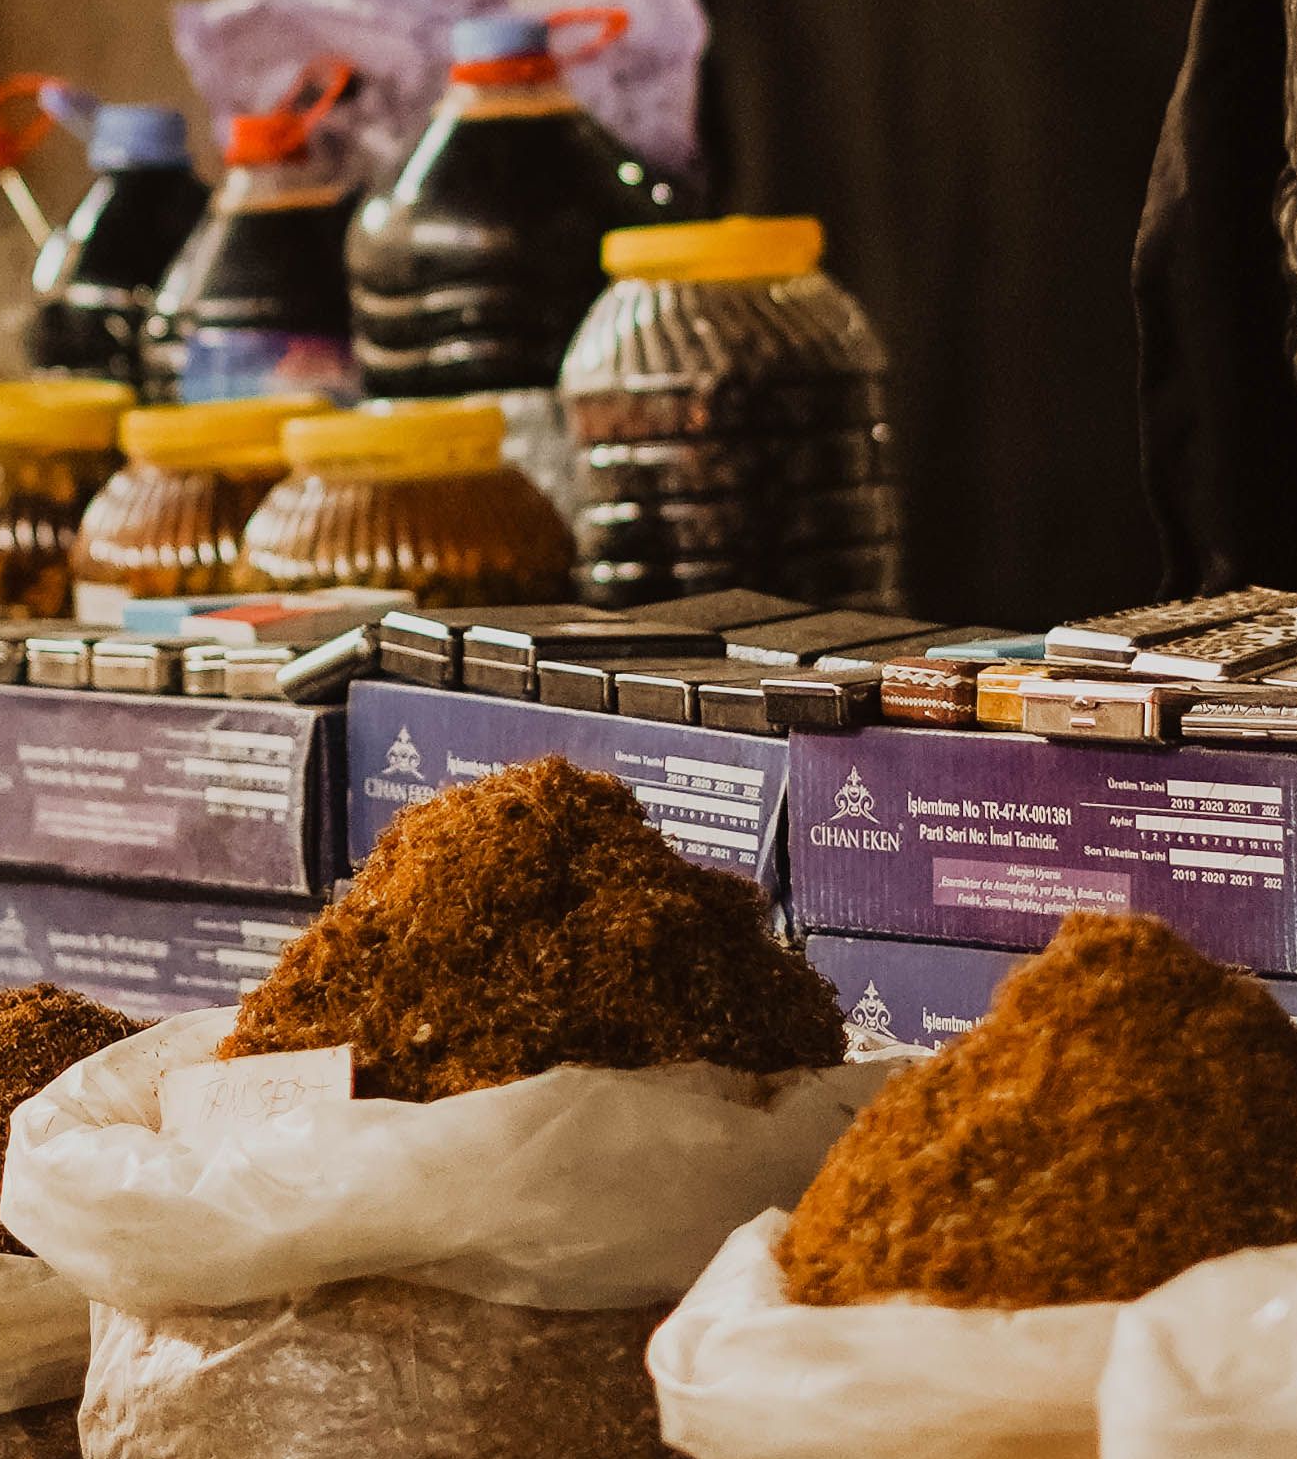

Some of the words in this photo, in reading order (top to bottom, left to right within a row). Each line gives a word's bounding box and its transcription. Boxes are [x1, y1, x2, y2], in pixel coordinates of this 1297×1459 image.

[1107, 777, 1138, 791] Üretim
[1139, 781, 1166, 793] Tarihi
[907, 791, 961, 819] İşlemtme
[962, 800, 980, 819] No
[982, 801, 1073, 826] TR-47-K-001361
[1170, 798, 1195, 810] 2019
[1199, 800, 1224, 812] 2020
[1228, 802, 1252, 814] 2021
[1261, 804, 1280, 817] 2022
[1109, 815, 1134, 828] Aylar
[810, 822, 860, 848] CİHAN
[863, 828, 901, 852] EKEN
[919, 823, 944, 842] Parti
[946, 826, 967, 843] Seri
[969, 828, 988, 846] No:
[990, 826, 1012, 847] İmal
[1014, 832, 1059, 851] Tarihidir.
[1083, 845, 1102, 857] Son
[1103, 846, 1139, 860] Tüketim
[1140, 850, 1166, 862] Tarihi
[1172, 868, 1197, 881] 2019
[1201, 871, 1226, 884] 2020
[1229, 874, 1253, 887] 2021
[1263, 876, 1282, 890] 2022
[922, 1007, 972, 1033] İşlemtme
